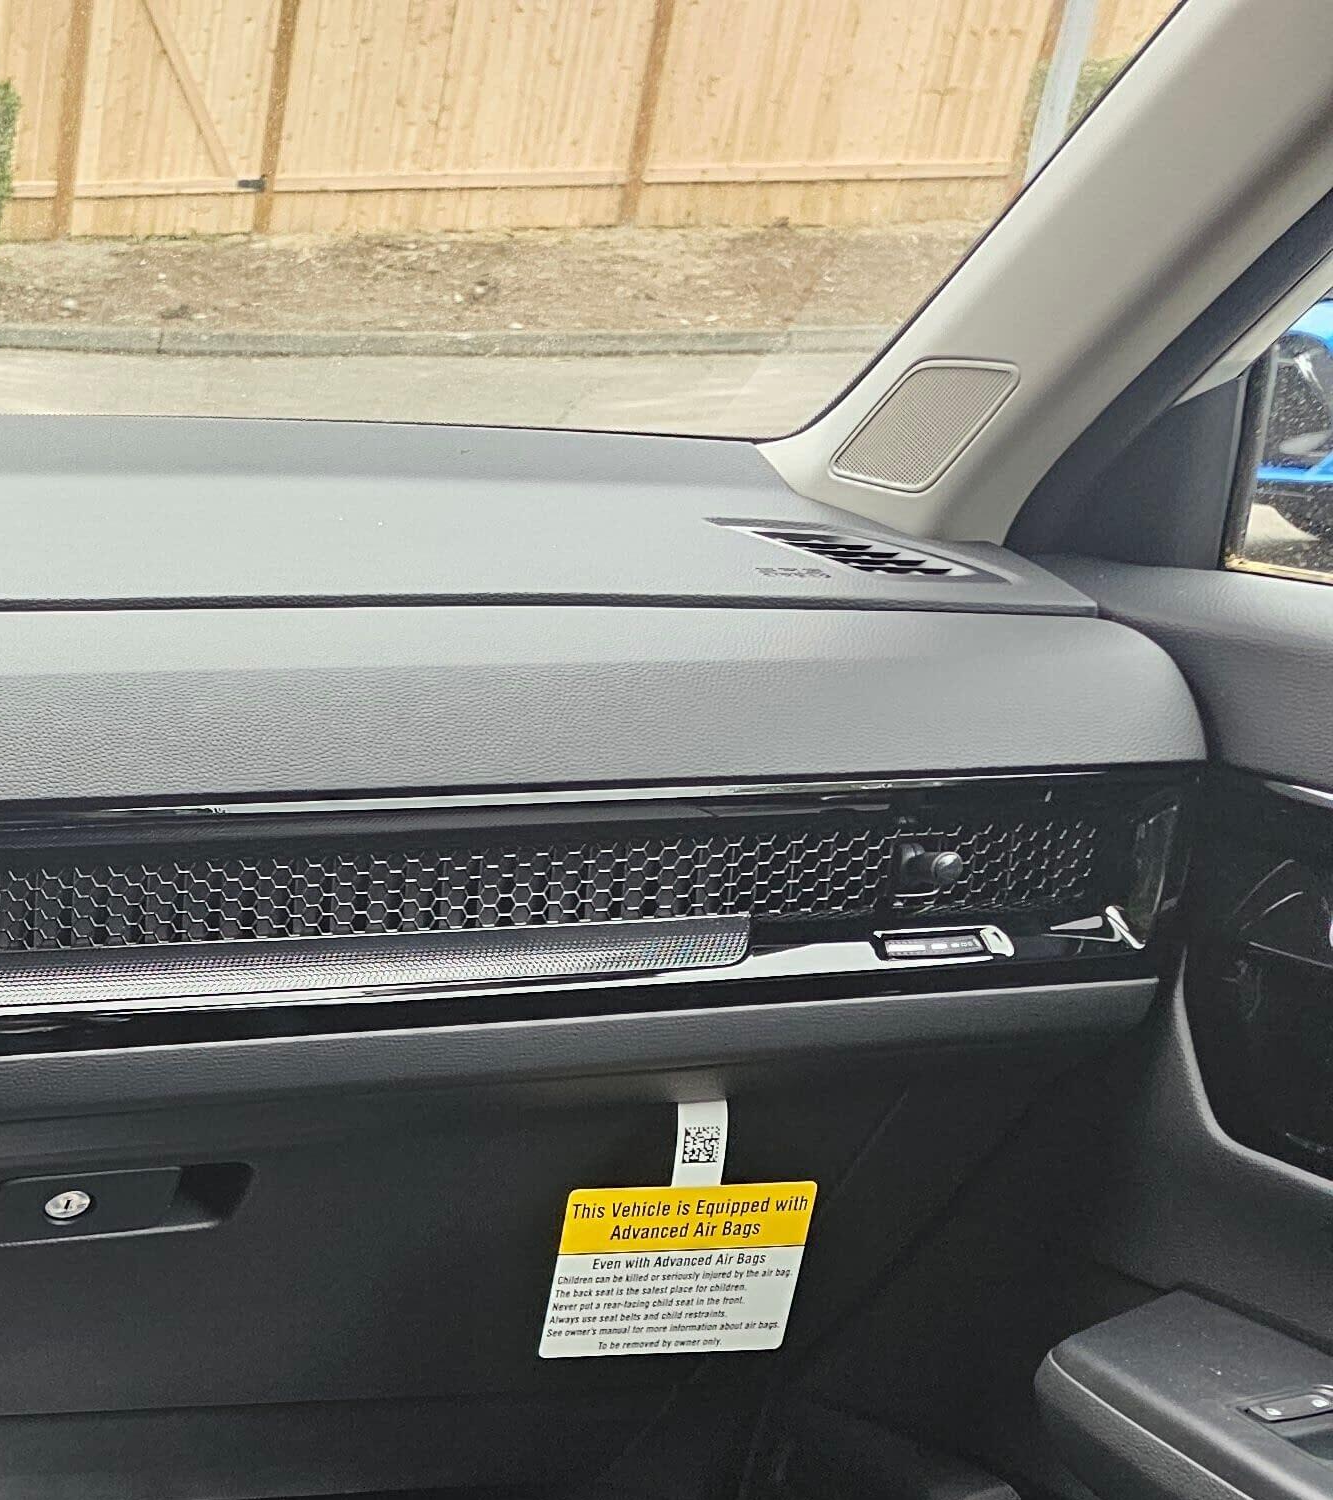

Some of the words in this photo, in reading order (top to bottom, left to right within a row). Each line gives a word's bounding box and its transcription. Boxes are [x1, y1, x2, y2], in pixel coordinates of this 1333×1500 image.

[573, 1203, 605, 1218] This
[612, 1201, 670, 1217] Vehicle
[677, 1200, 690, 1215] is
[696, 1197, 770, 1217] Equipped
[776, 1196, 808, 1211] with
[610, 1222, 689, 1240] Advanced
[693, 1221, 717, 1237] Air
[722, 1221, 761, 1238] Bags
[592, 1258, 621, 1270] Even
[625, 1257, 650, 1269] with
[653, 1254, 712, 1268] Advanced
[715, 1253, 734, 1266] Air
[736, 1253, 766, 1266] Bags
[557, 1276, 593, 1285] Children
[612, 1275, 623, 1283] be
[625, 1273, 649, 1282] killed
[661, 1271, 699, 1281] seriously
[702, 1270, 732, 1280] injured
[734, 1270, 744, 1279] by
[746, 1269, 759, 1278] the
[761, 1269, 773, 1277] air
[555, 1289, 570, 1298] The
[573, 1288, 592, 1297] back
[595, 1288, 614, 1297] seat
[616, 1287, 623, 1296] is
[626, 1286, 639, 1295] the
[642, 1285, 667, 1295] safest
[670, 1285, 693, 1294] place
[695, 1284, 708, 1293] for
[552, 1302, 577, 1311] Never
[579, 1301, 593, 1311] put
[652, 1299, 673, 1307] child
[676, 1297, 694, 1306] seat
[696, 1297, 704, 1305] in
[707, 1297, 720, 1305] the
[549, 1315, 579, 1325] Always
[599, 1314, 617, 1322] seat
[620, 1313, 641, 1321] belts
[643, 1312, 659, 1320] and
[661, 1311, 682, 1319] child
[546, 1329, 562, 1337] See
[564, 1327, 596, 1336] owner's
[599, 1326, 630, 1335] manual
[632, 1326, 644, 1334] for
[646, 1325, 667, 1333] more
[669, 1323, 718, 1332] information
[719, 1322, 743, 1331] about
[745, 1321, 756, 1329] air
[598, 1342, 607, 1350] To
[610, 1341, 620, 1349] be
[622, 1340, 660, 1349] removed
[662, 1340, 671, 1349] by
[674, 1339, 700, 1347] owner
